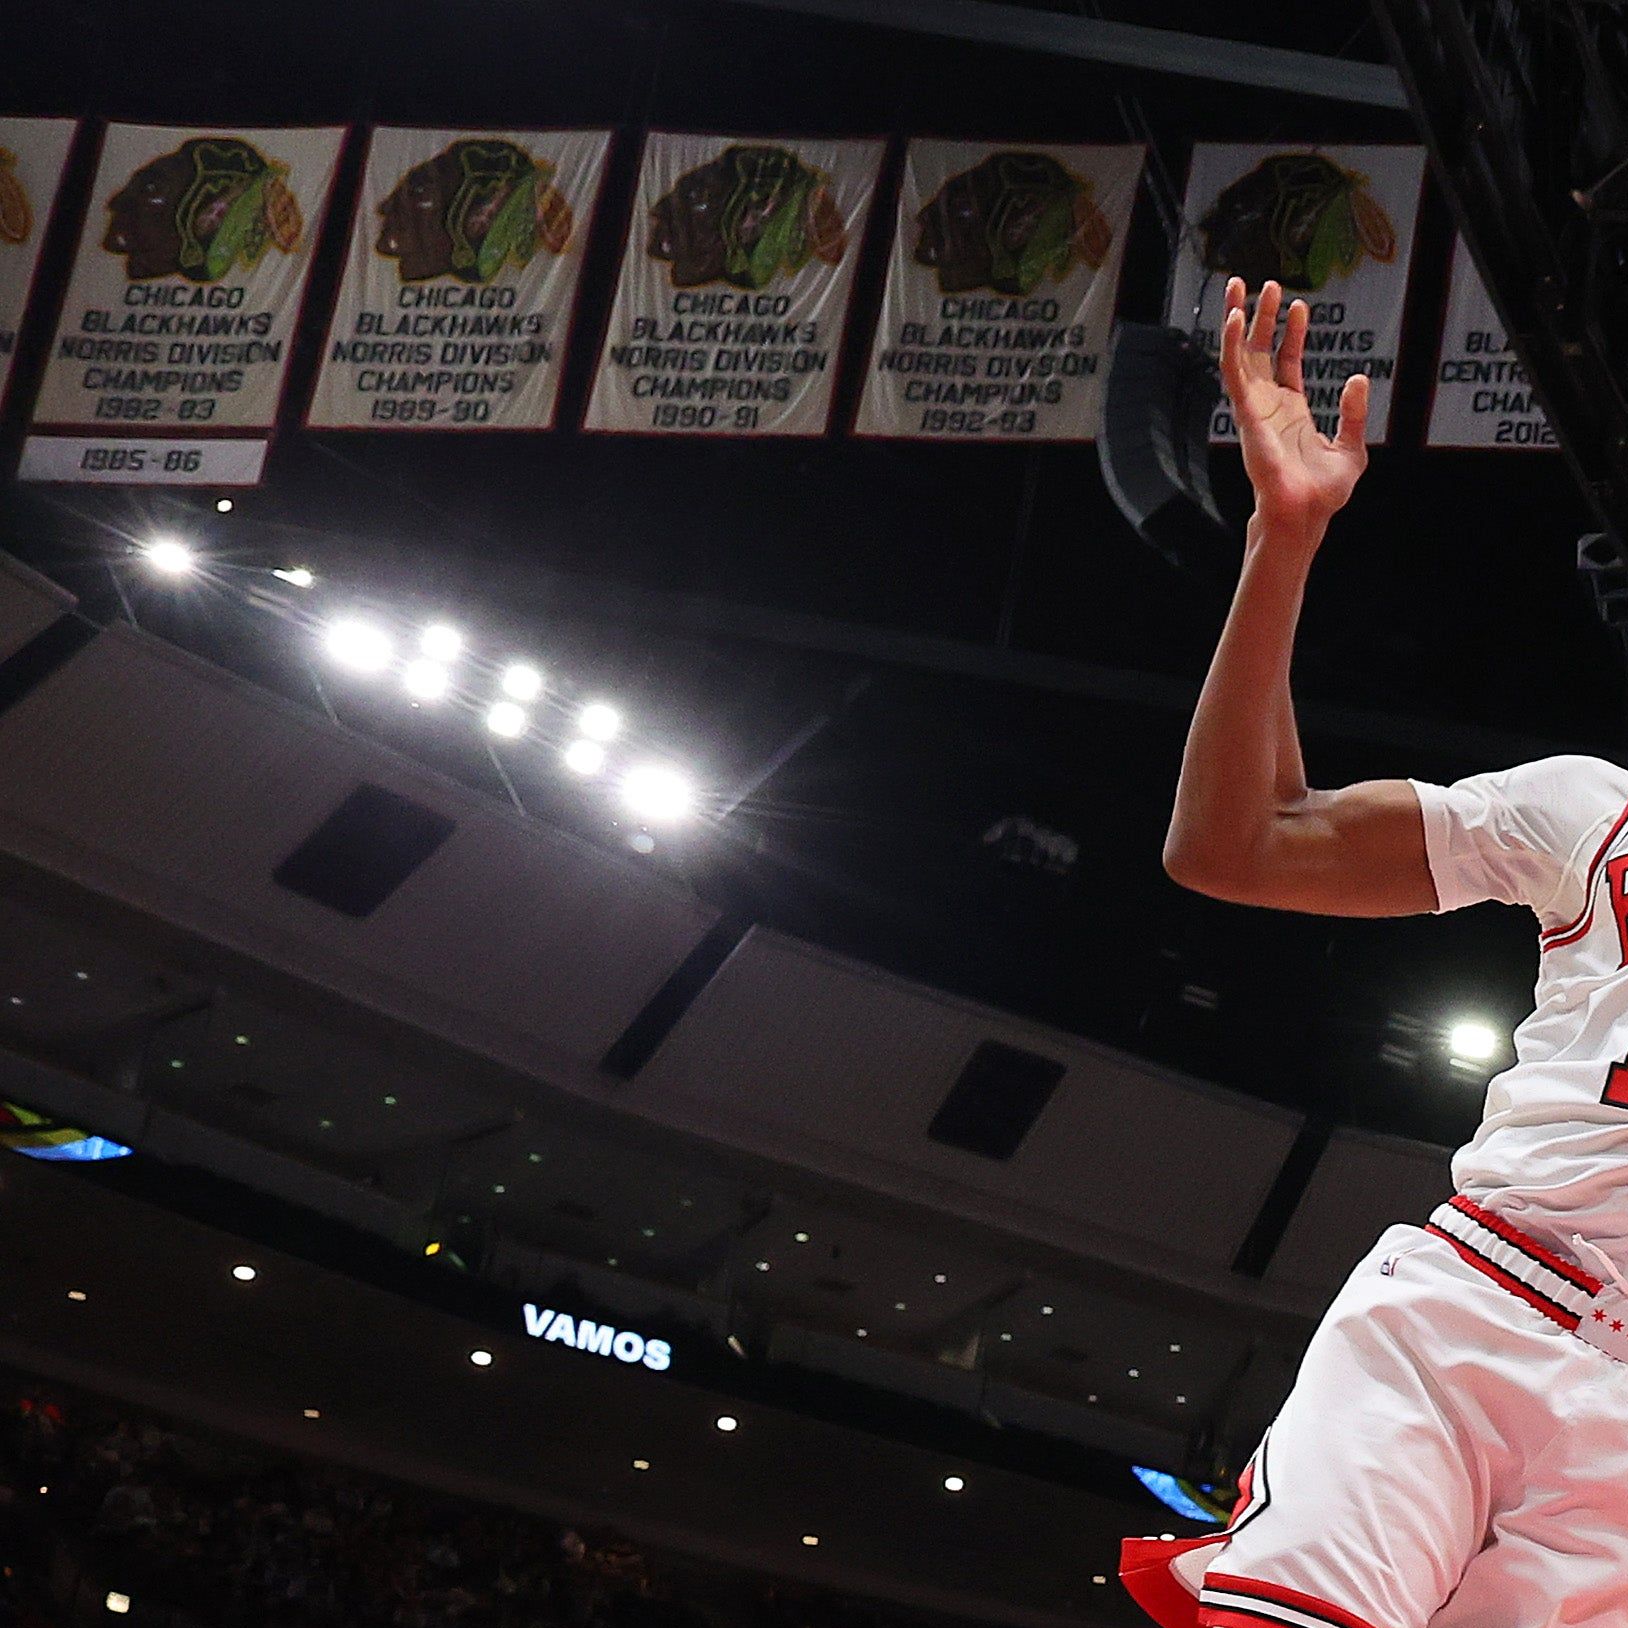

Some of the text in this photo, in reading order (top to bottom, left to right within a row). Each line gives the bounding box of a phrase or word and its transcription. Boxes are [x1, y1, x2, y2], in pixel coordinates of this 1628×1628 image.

[125, 286, 243, 308] CHICAGO
[398, 287, 516, 309] CHICAGO
[673, 292, 790, 316] CHICAGO
[81, 310, 272, 336] BLACKHAWKS
[941, 299, 1058, 322] CHICAGO
[356, 312, 541, 337] BLACKHAWKS
[632, 318, 816, 343] BLACKHAWKS
[901, 322, 1085, 349] BLACKHAWKS
[167, 340, 282, 365] DIVISION
[333, 340, 552, 366] NORRIS DIVISION
[879, 352, 977, 377] NORRIS
[84, 368, 243, 393] CHAMPIONS
[357, 370, 514, 393] CHAMPIONS
[632, 375, 791, 401] CHAMPIONS
[522, 1303, 672, 1371] VAMOS
